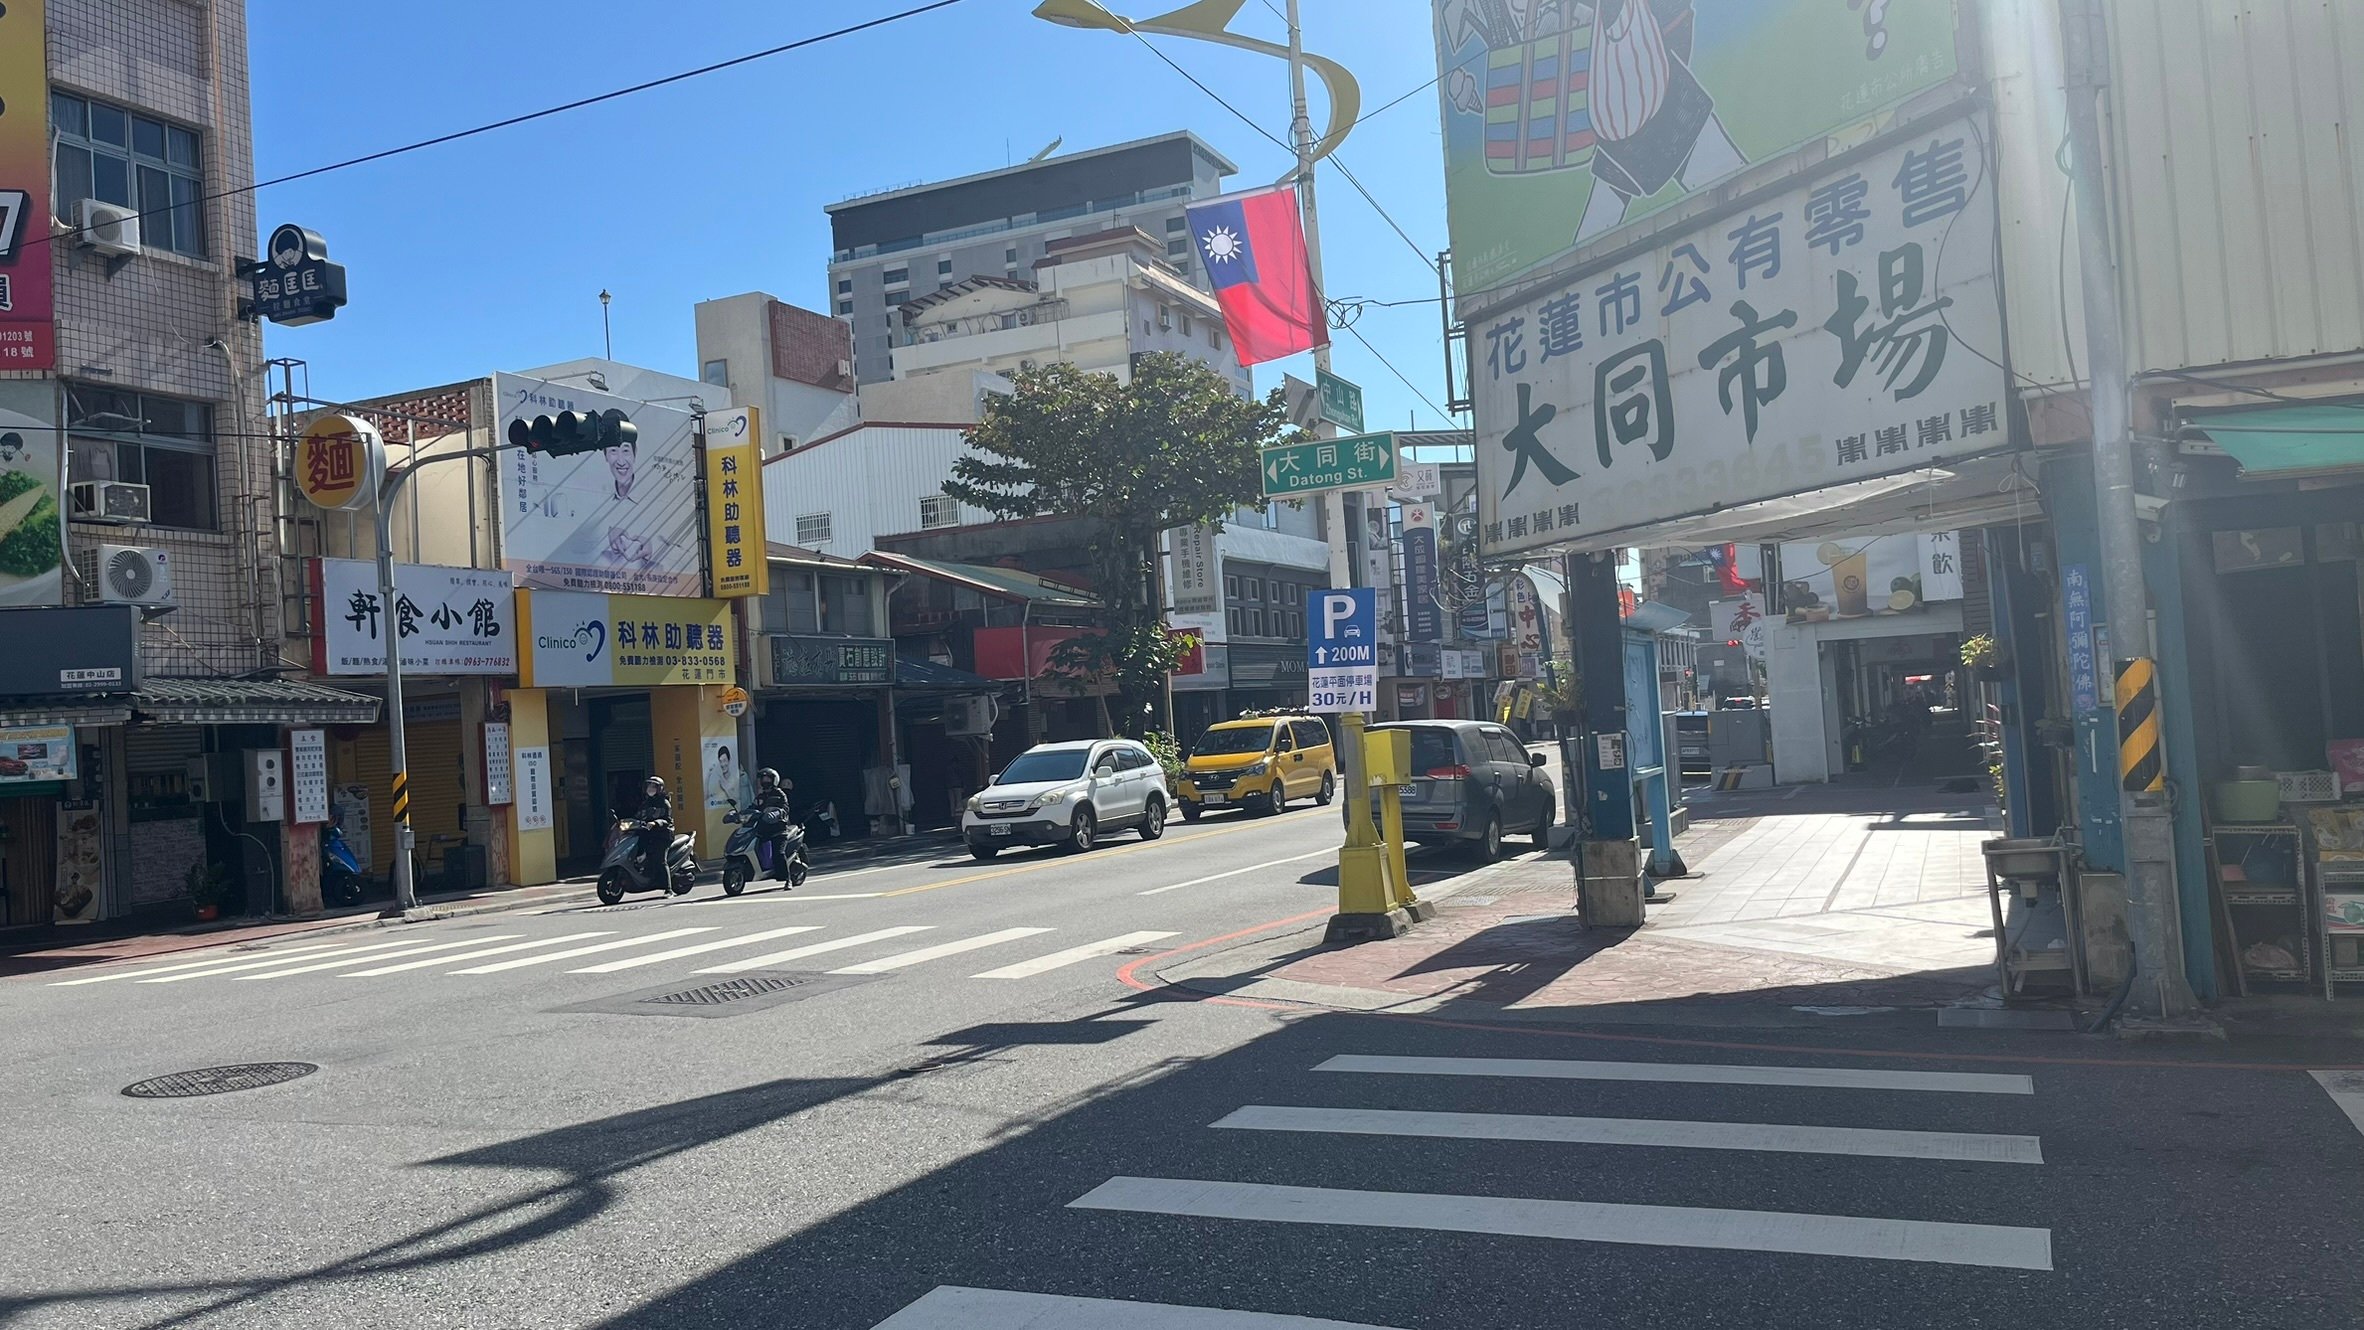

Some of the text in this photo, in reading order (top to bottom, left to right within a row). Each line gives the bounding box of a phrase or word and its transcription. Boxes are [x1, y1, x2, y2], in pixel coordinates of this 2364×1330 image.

[1485, 137, 1969, 381] 花蓮市公有零售
[1501, 241, 1954, 503] 大同市場
[1322, 378, 1358, 411] 中山路
[707, 426, 730, 436] Clinico
[306, 430, 357, 495] 麵
[1279, 441, 1376, 473] 大同街
[1289, 467, 1368, 487] Datong St.
[721, 455, 743, 568] 科林助聽器
[1195, 560, 1204, 588] Store
[345, 589, 501, 639] 軒食小館
[1323, 594, 1356, 639] P
[538, 636, 577, 649] Clinico
[617, 620, 725, 650] 科林助聽器
[2066, 569, 2093, 691] 南無阿彌陀佛
[463, 657, 510, 667] 0963-776832
[665, 655, 726, 666] 03-833-0568
[1280, 660, 1308, 673] MOM
[1331, 645, 1370, 662] 200M
[681, 668, 726, 680] 花蓮門市
[1312, 674, 1373, 689] 花蓮平面停車場
